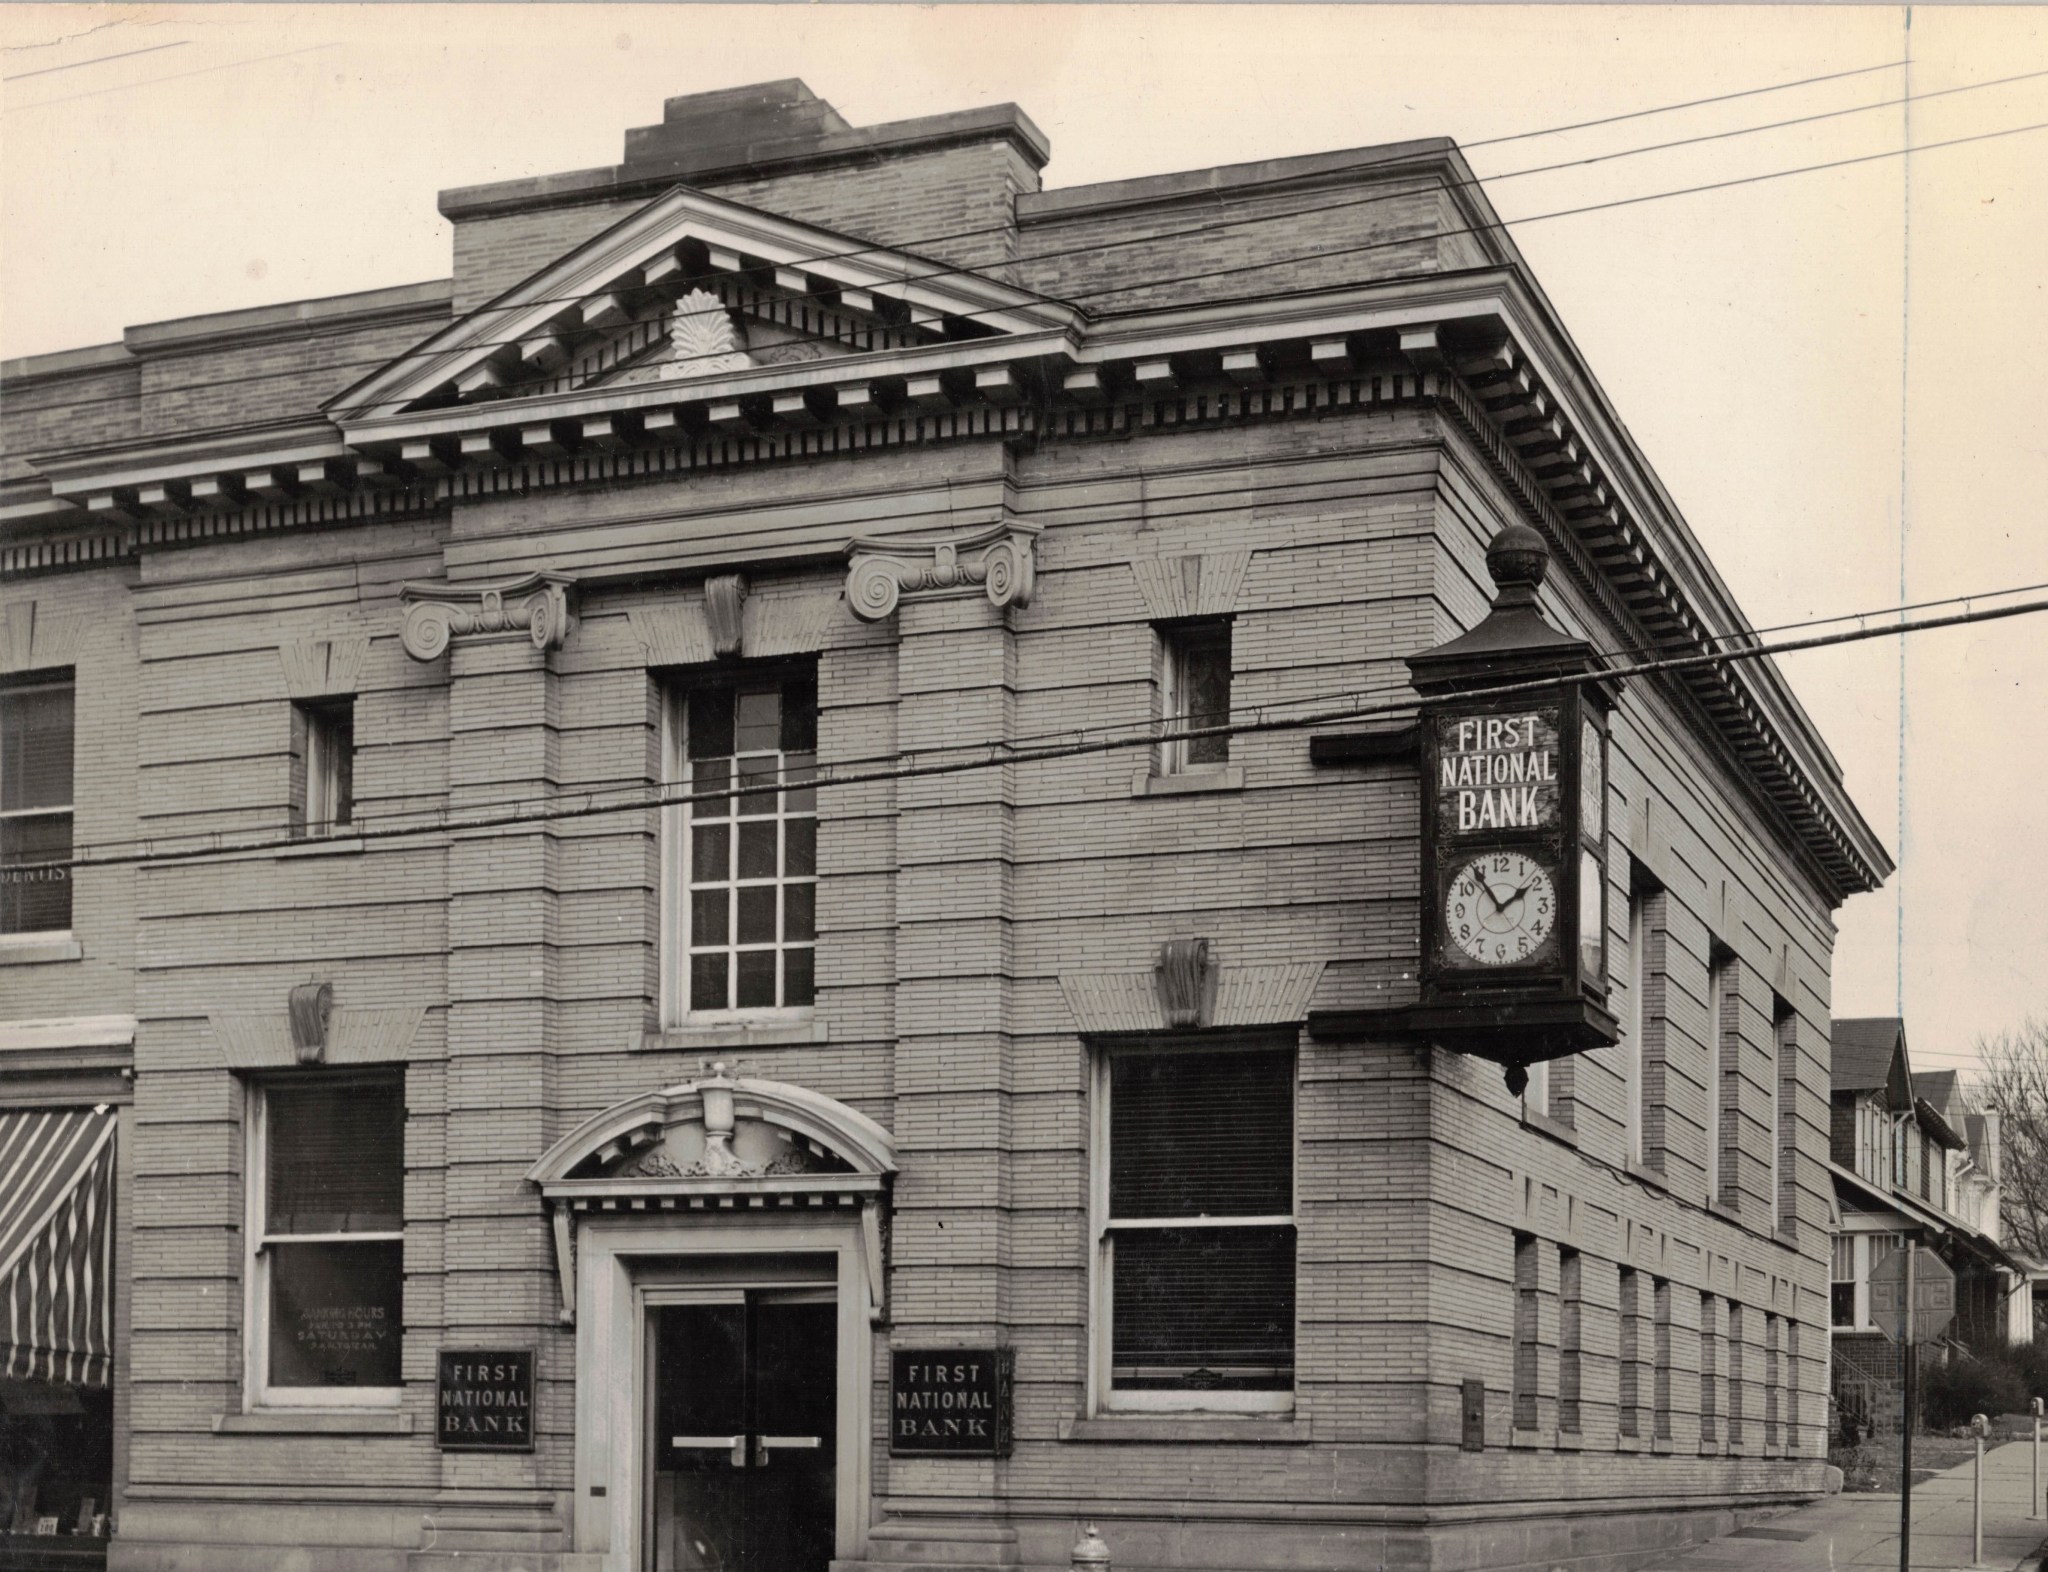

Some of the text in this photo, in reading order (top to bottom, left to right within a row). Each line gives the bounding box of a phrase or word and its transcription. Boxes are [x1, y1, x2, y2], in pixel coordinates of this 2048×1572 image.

[1459, 716, 1540, 751] FIRST
[1442, 751, 1557, 787] NATIONAL
[1458, 786, 1539, 830] BANK
[1493, 857, 1510, 873] 12
[1460, 881, 1475, 897] 10
[1532, 876, 1543, 891] 2
[1455, 902, 1465, 919] 9
[1537, 897, 1549, 914] 3
[1460, 924, 1471, 940] 8
[1530, 919, 1544, 936] 4
[1475, 938, 1485, 954] 7
[1496, 943, 1506, 960] 6
[1518, 937, 1528, 954] 5
[297, 1331, 387, 1341] SATURDAY
[454, 1365, 518, 1381] FIRST
[909, 1365, 979, 1382] FIRST
[442, 1390, 528, 1407] NATIONAL
[896, 1391, 992, 1409] NATIONAL
[444, 1416, 525, 1432] BANK
[900, 1419, 988, 1436] BANK
